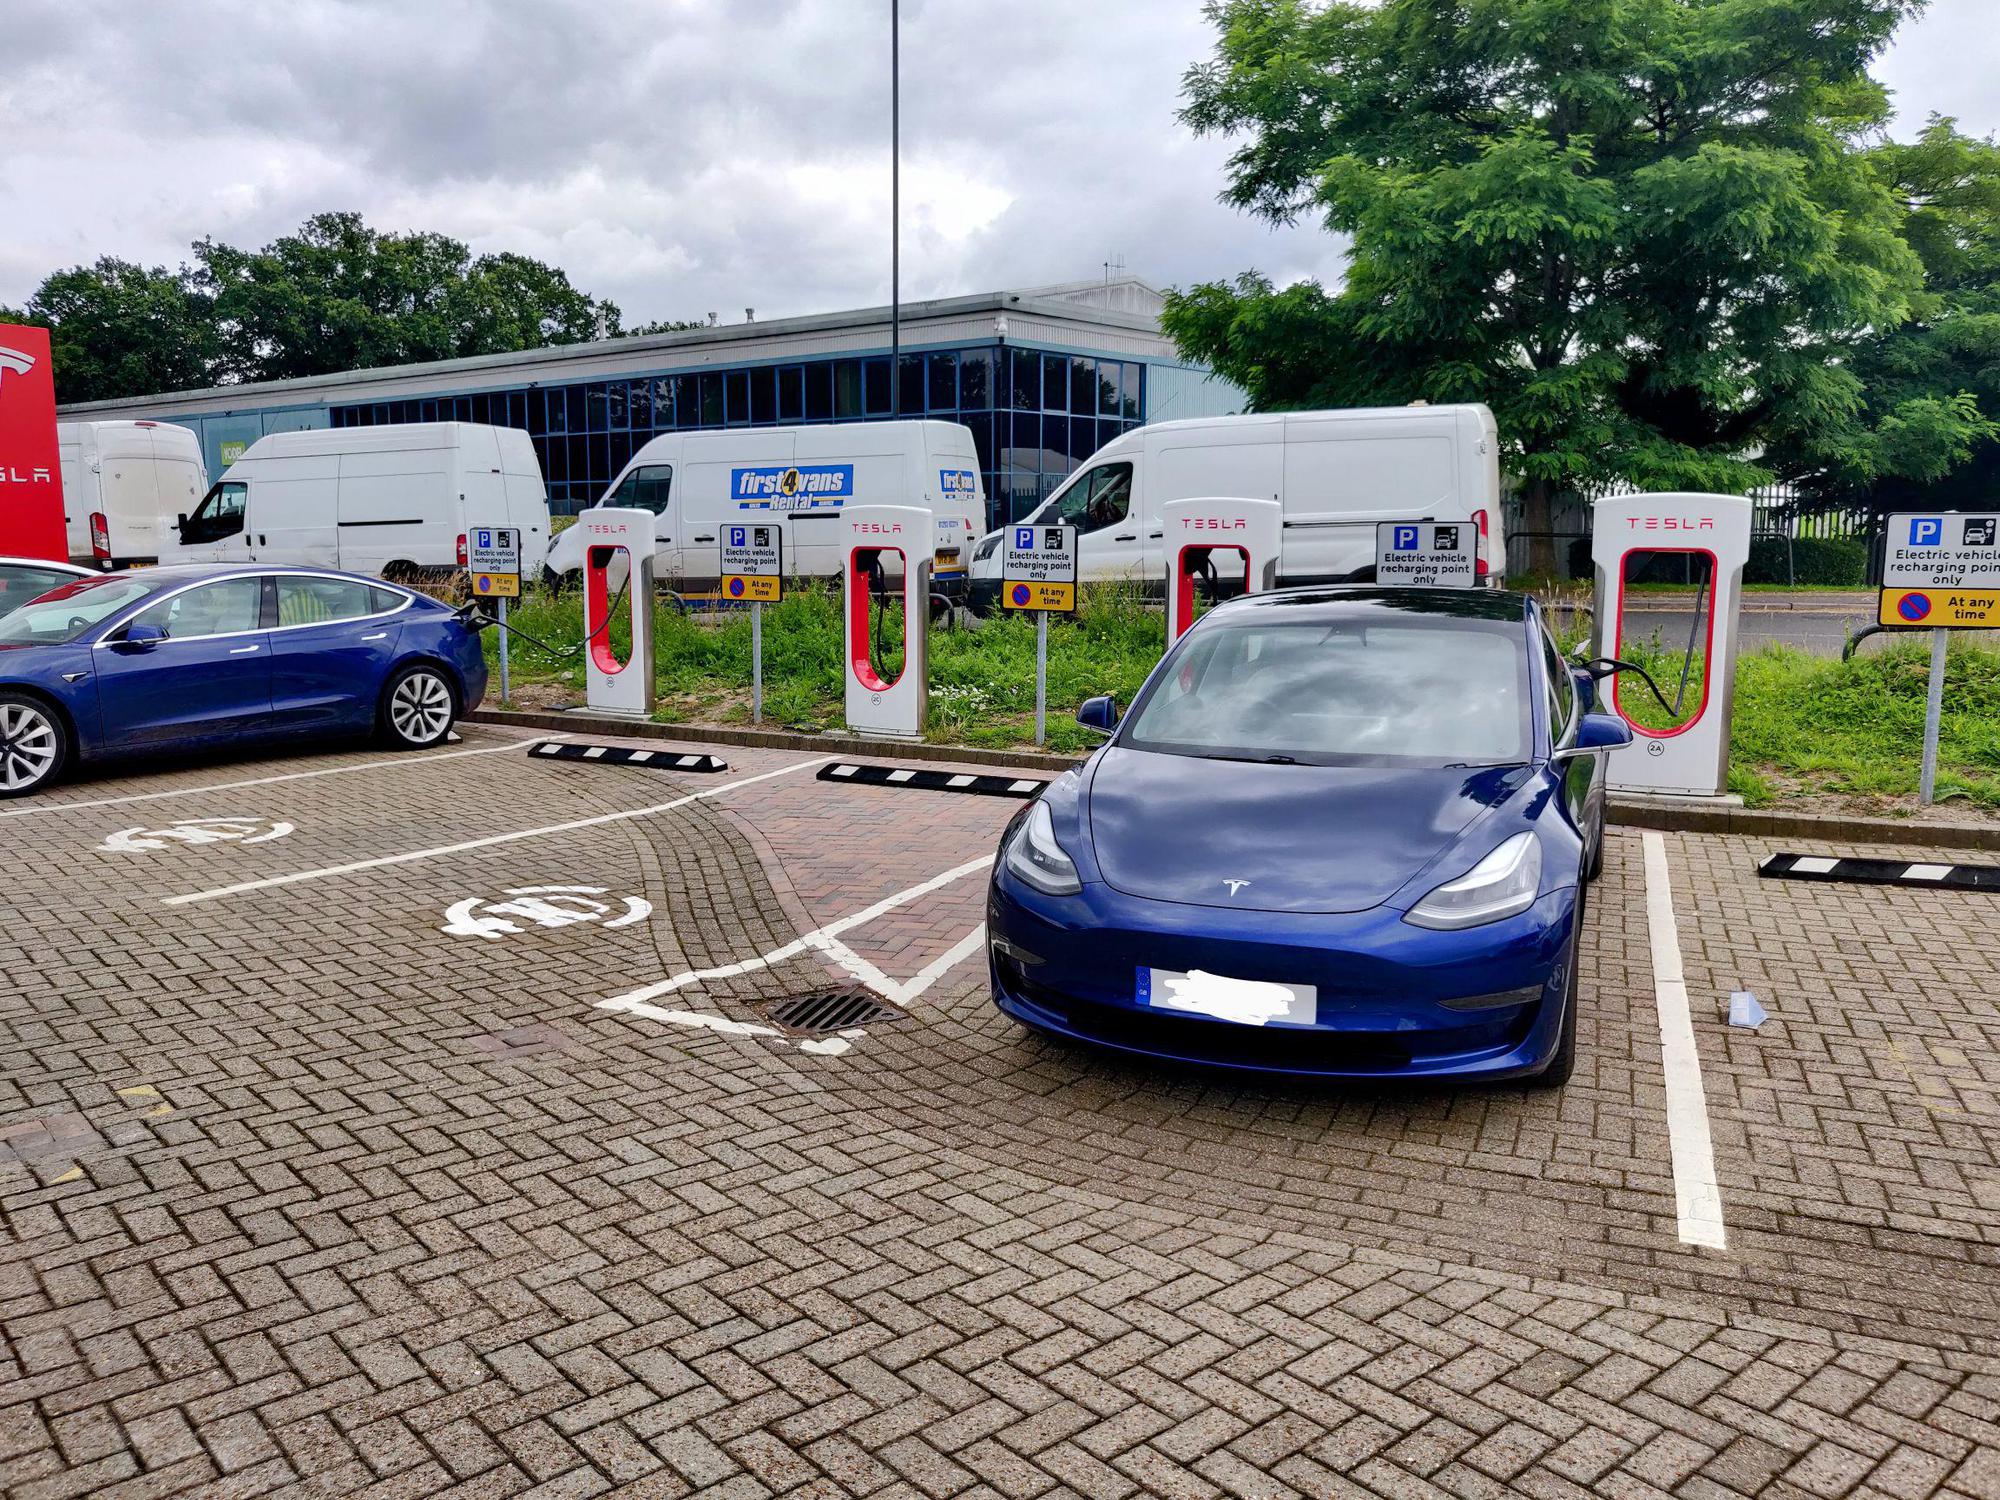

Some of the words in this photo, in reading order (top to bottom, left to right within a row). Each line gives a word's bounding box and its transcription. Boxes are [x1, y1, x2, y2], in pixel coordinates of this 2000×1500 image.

[769, 493, 814, 511] Rental
[852, 523, 902, 533] TESLA
[1182, 518, 1246, 529] TESLA
[1626, 518, 1713, 530] TESLA
[588, 525, 627, 534] TESLA
[1916, 521, 1937, 544] P
[733, 530, 743, 545] P
[1019, 530, 1031, 547] P
[1399, 529, 1414, 548] P
[1009, 551, 1039, 560] Electric
[1041, 552, 1069, 560] vehicle
[1384, 553, 1425, 562] Electric
[1429, 553, 1467, 562] vehicle
[1895, 549, 1950, 560] Electric
[724, 557, 758, 565] recharging
[760, 557, 777, 565] point
[1006, 561, 1048, 570] recharging
[1050, 562, 1071, 570] point
[743, 565, 757, 573] only
[1380, 564, 1438, 574] recharging
[1441, 564, 1470, 574] point
[1890, 562, 1966, 574] recharging
[1029, 570, 1047, 579] only
[1413, 575, 1436, 584] only
[1932, 575, 1963, 586] only
[1039, 587, 1049, 595] At
[1051, 589, 1065, 597] any
[1043, 597, 1061, 605] time
[1948, 596, 1965, 607] At
[1969, 599, 1995, 609] any
[1954, 609, 1986, 619] time
[1650, 744, 1662, 752] 2A
[1138, 988, 1148, 996] GB
